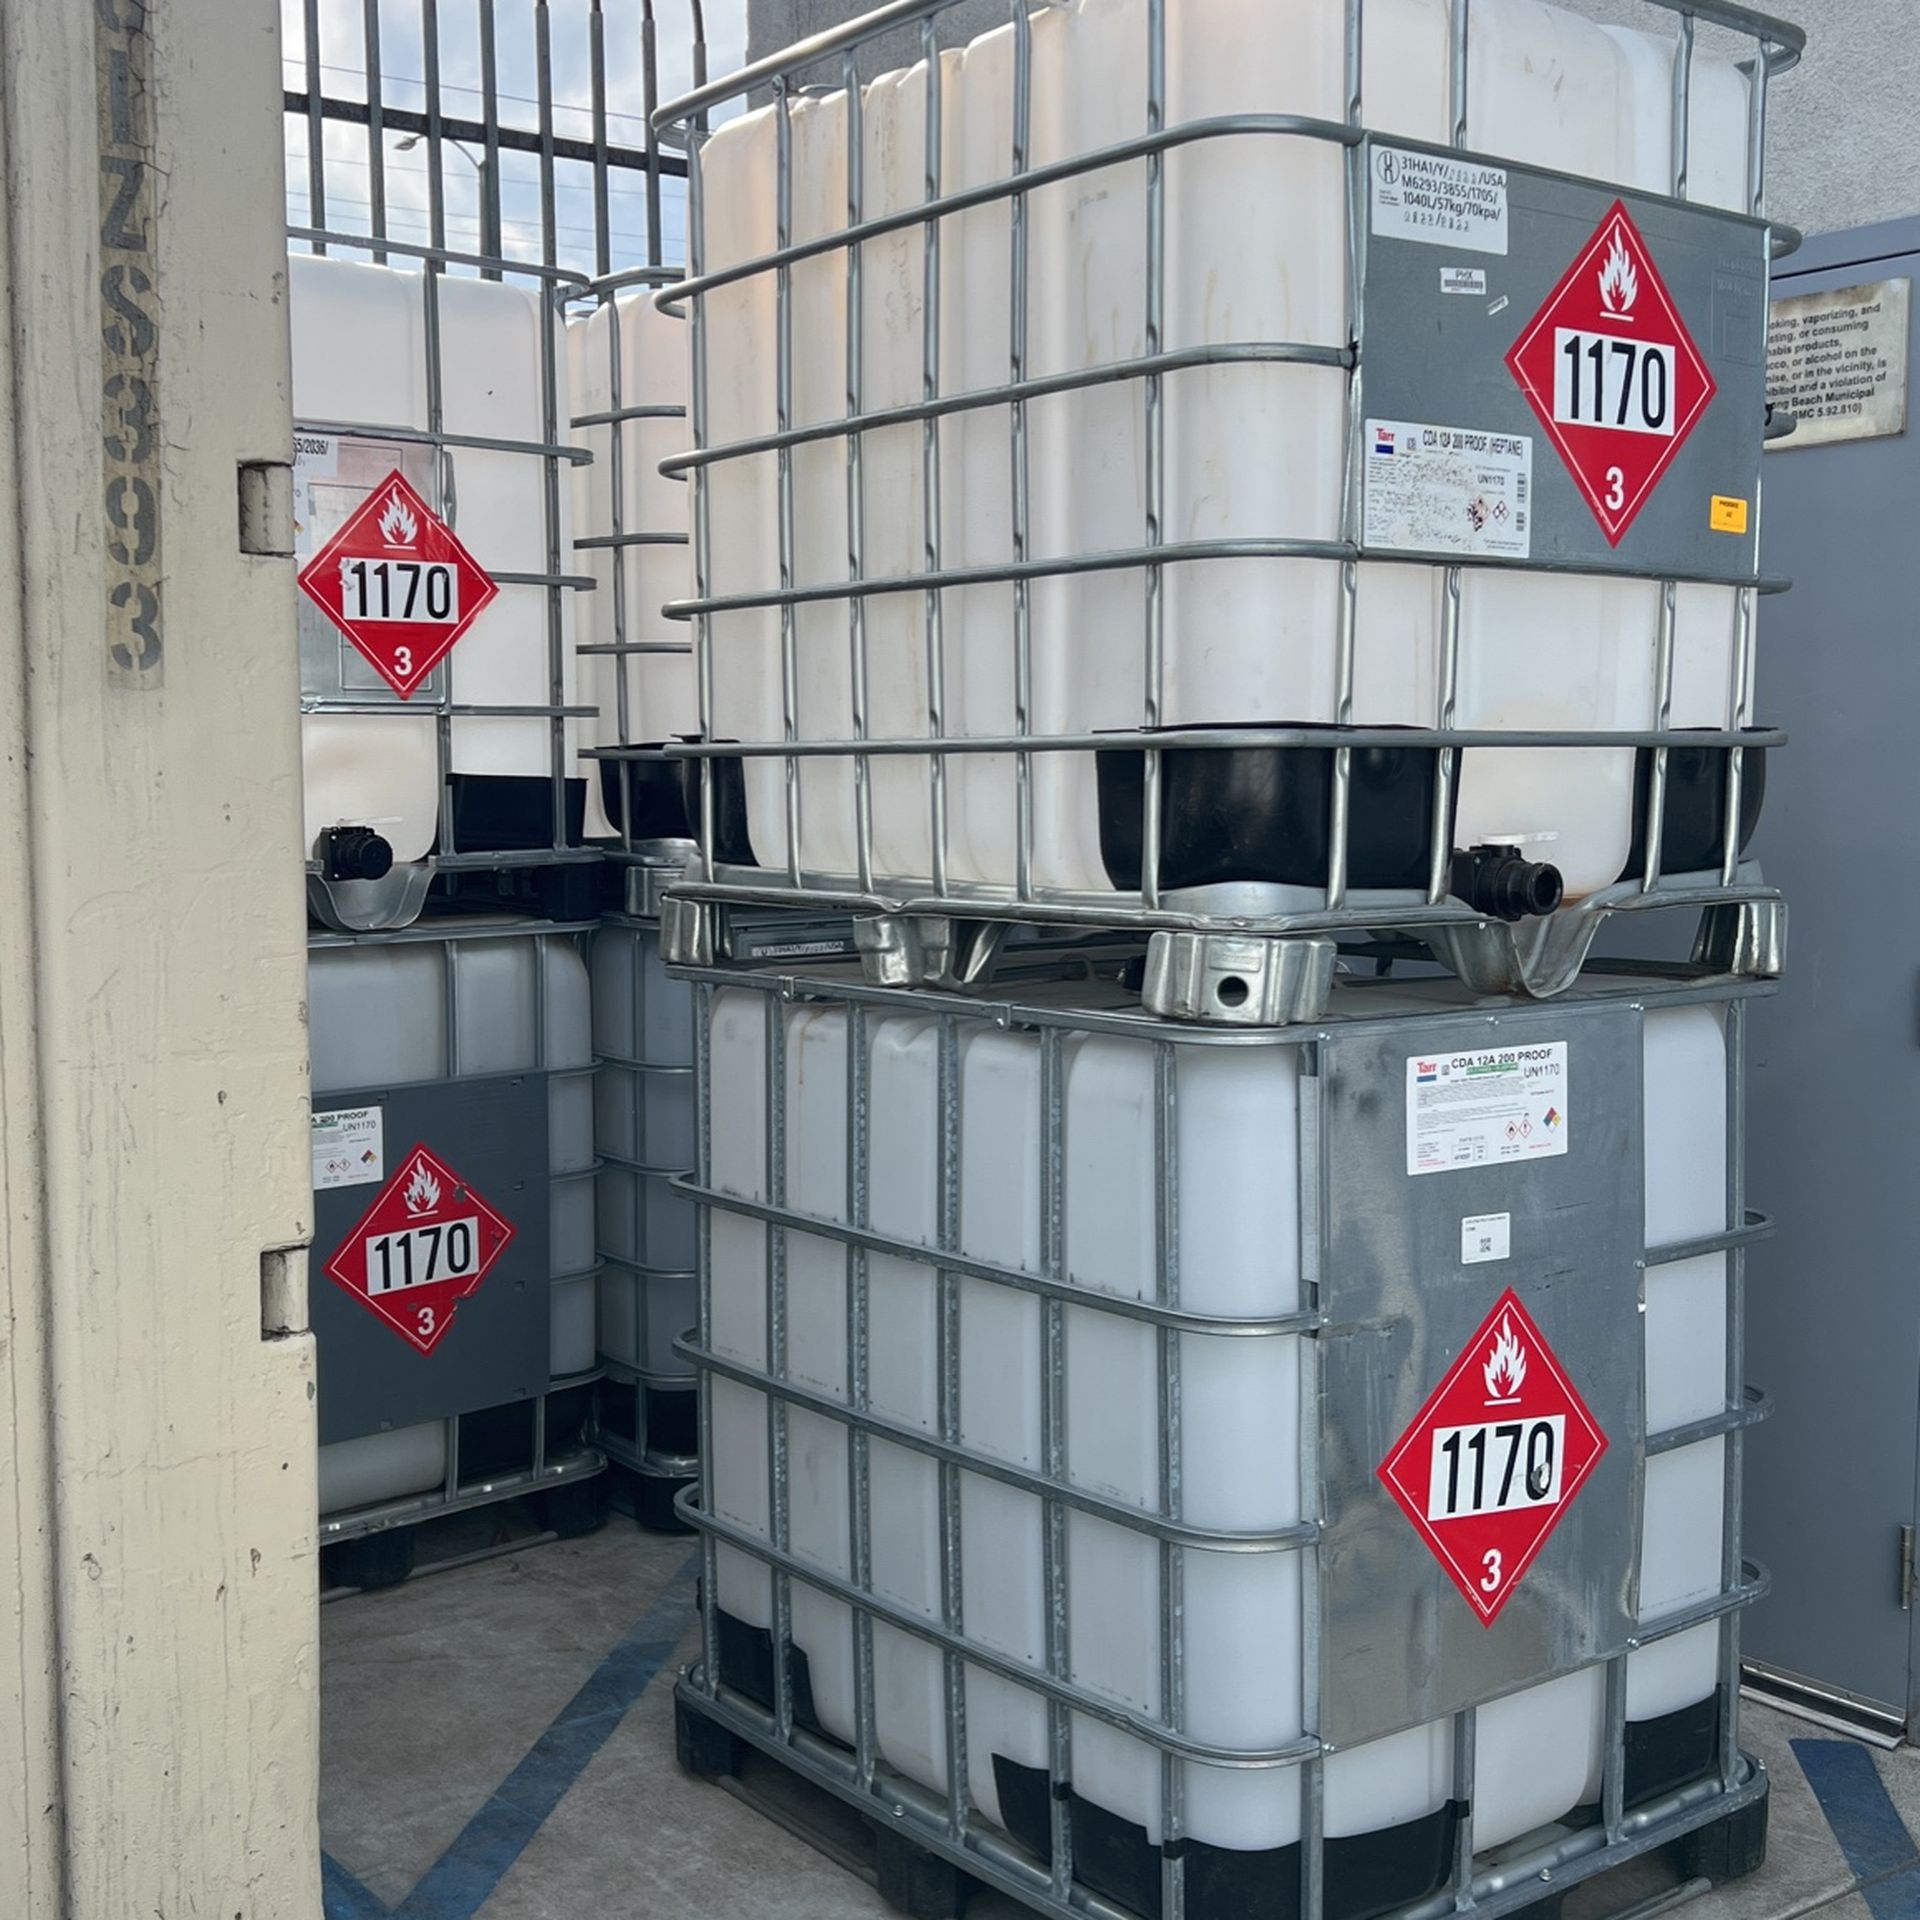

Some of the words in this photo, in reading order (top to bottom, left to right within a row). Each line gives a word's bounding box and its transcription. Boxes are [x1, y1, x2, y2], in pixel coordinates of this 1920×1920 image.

[1802, 309, 1858, 325] vaporizing,
[1861, 302, 1881, 315] and
[1799, 330, 1810, 339] or
[1812, 320, 1869, 337] consuming
[1792, 358, 1803, 367] or
[1805, 350, 1842, 365] alcohol
[1844, 350, 1858, 359] on
[1860, 346, 1877, 357] the
[1795, 339, 1842, 354] products,
[1791, 372, 1802, 380] or
[1804, 369, 1815, 378] in
[1817, 367, 1832, 377] the
[1835, 361, 1874, 373] vicinity,
[1877, 358, 1887, 368] is
[1564, 335, 1667, 428] 1170
[1799, 381, 1818, 392] and
[1820, 381, 1827, 390] a
[1829, 376, 1873, 388] violation
[1875, 370, 1887, 382] of
[1791, 394, 1823, 407] Beach
[1825, 385, 1875, 402] Municipal
[1376, 427, 1396, 442] Tarr
[1423, 429, 1438, 446] CDA
[1477, 473, 1505, 486] UN1170
[1605, 466, 1625, 510] 3
[351, 561, 451, 619] 1170
[394, 646, 412, 676] 3
[1417, 1061, 1437, 1074] Tarr
[1451, 1057, 1474, 1069] CDA
[1477, 1055, 1496, 1066] 12A
[1498, 1052, 1515, 1064] 200
[1517, 1049, 1552, 1062] PROOF
[1524, 1063, 1560, 1079] UN1170
[337, 1110, 368, 1121] PROOF
[343, 1119, 376, 1132] UN1170
[374, 1222, 471, 1290] 1170
[417, 1306, 436, 1336] 3
[1442, 1422, 1556, 1514] 1170
[1480, 1548, 1502, 1593] 3
